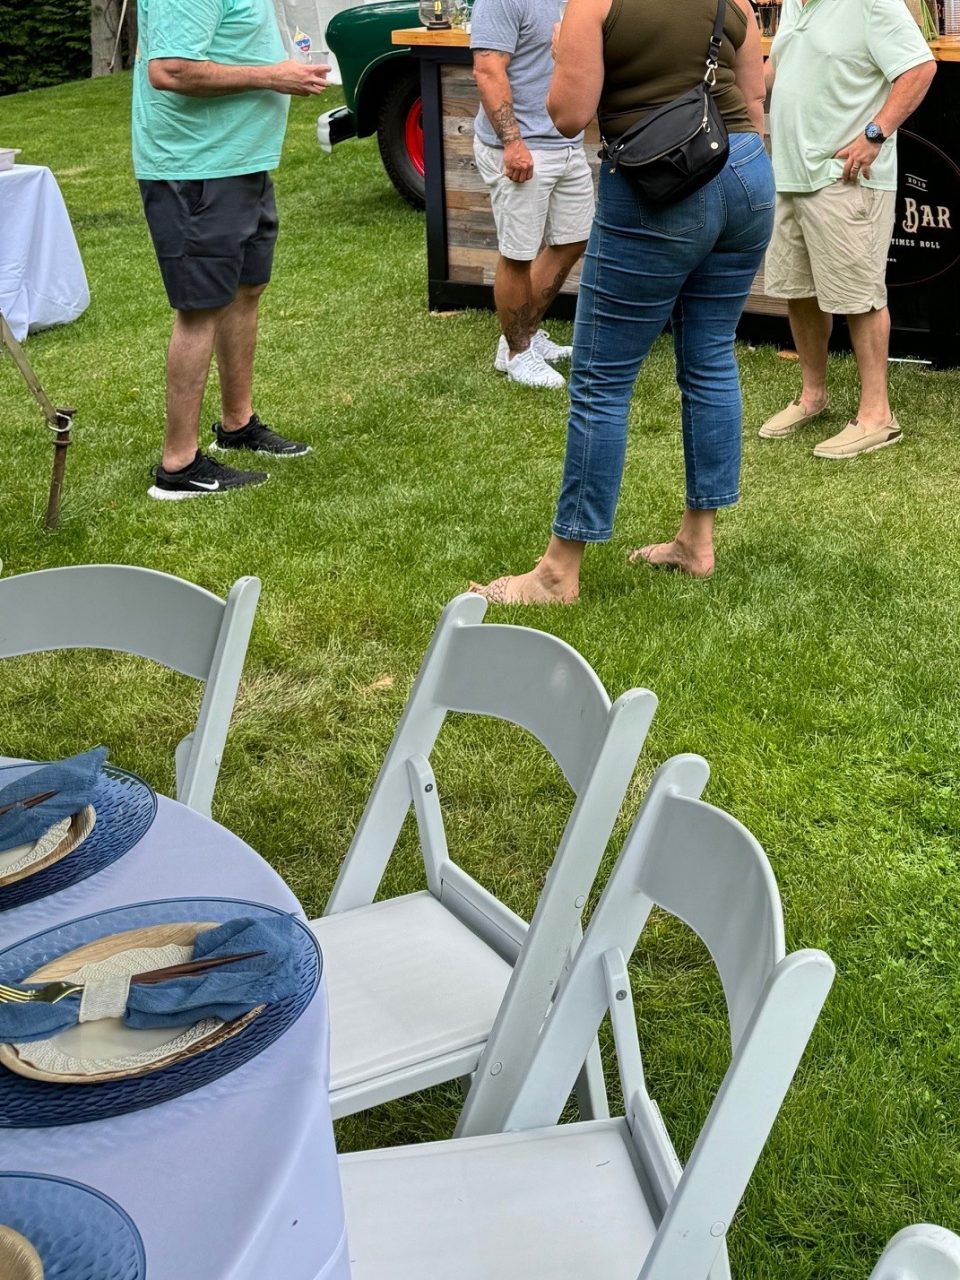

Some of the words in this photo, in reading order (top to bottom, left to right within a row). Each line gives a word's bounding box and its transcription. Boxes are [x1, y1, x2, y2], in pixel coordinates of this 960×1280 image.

[908, 177, 927, 188] 2019
[902, 197, 952, 233] BAR
[891, 238, 915, 247] TIMES
[920, 240, 940, 249] ROLL
